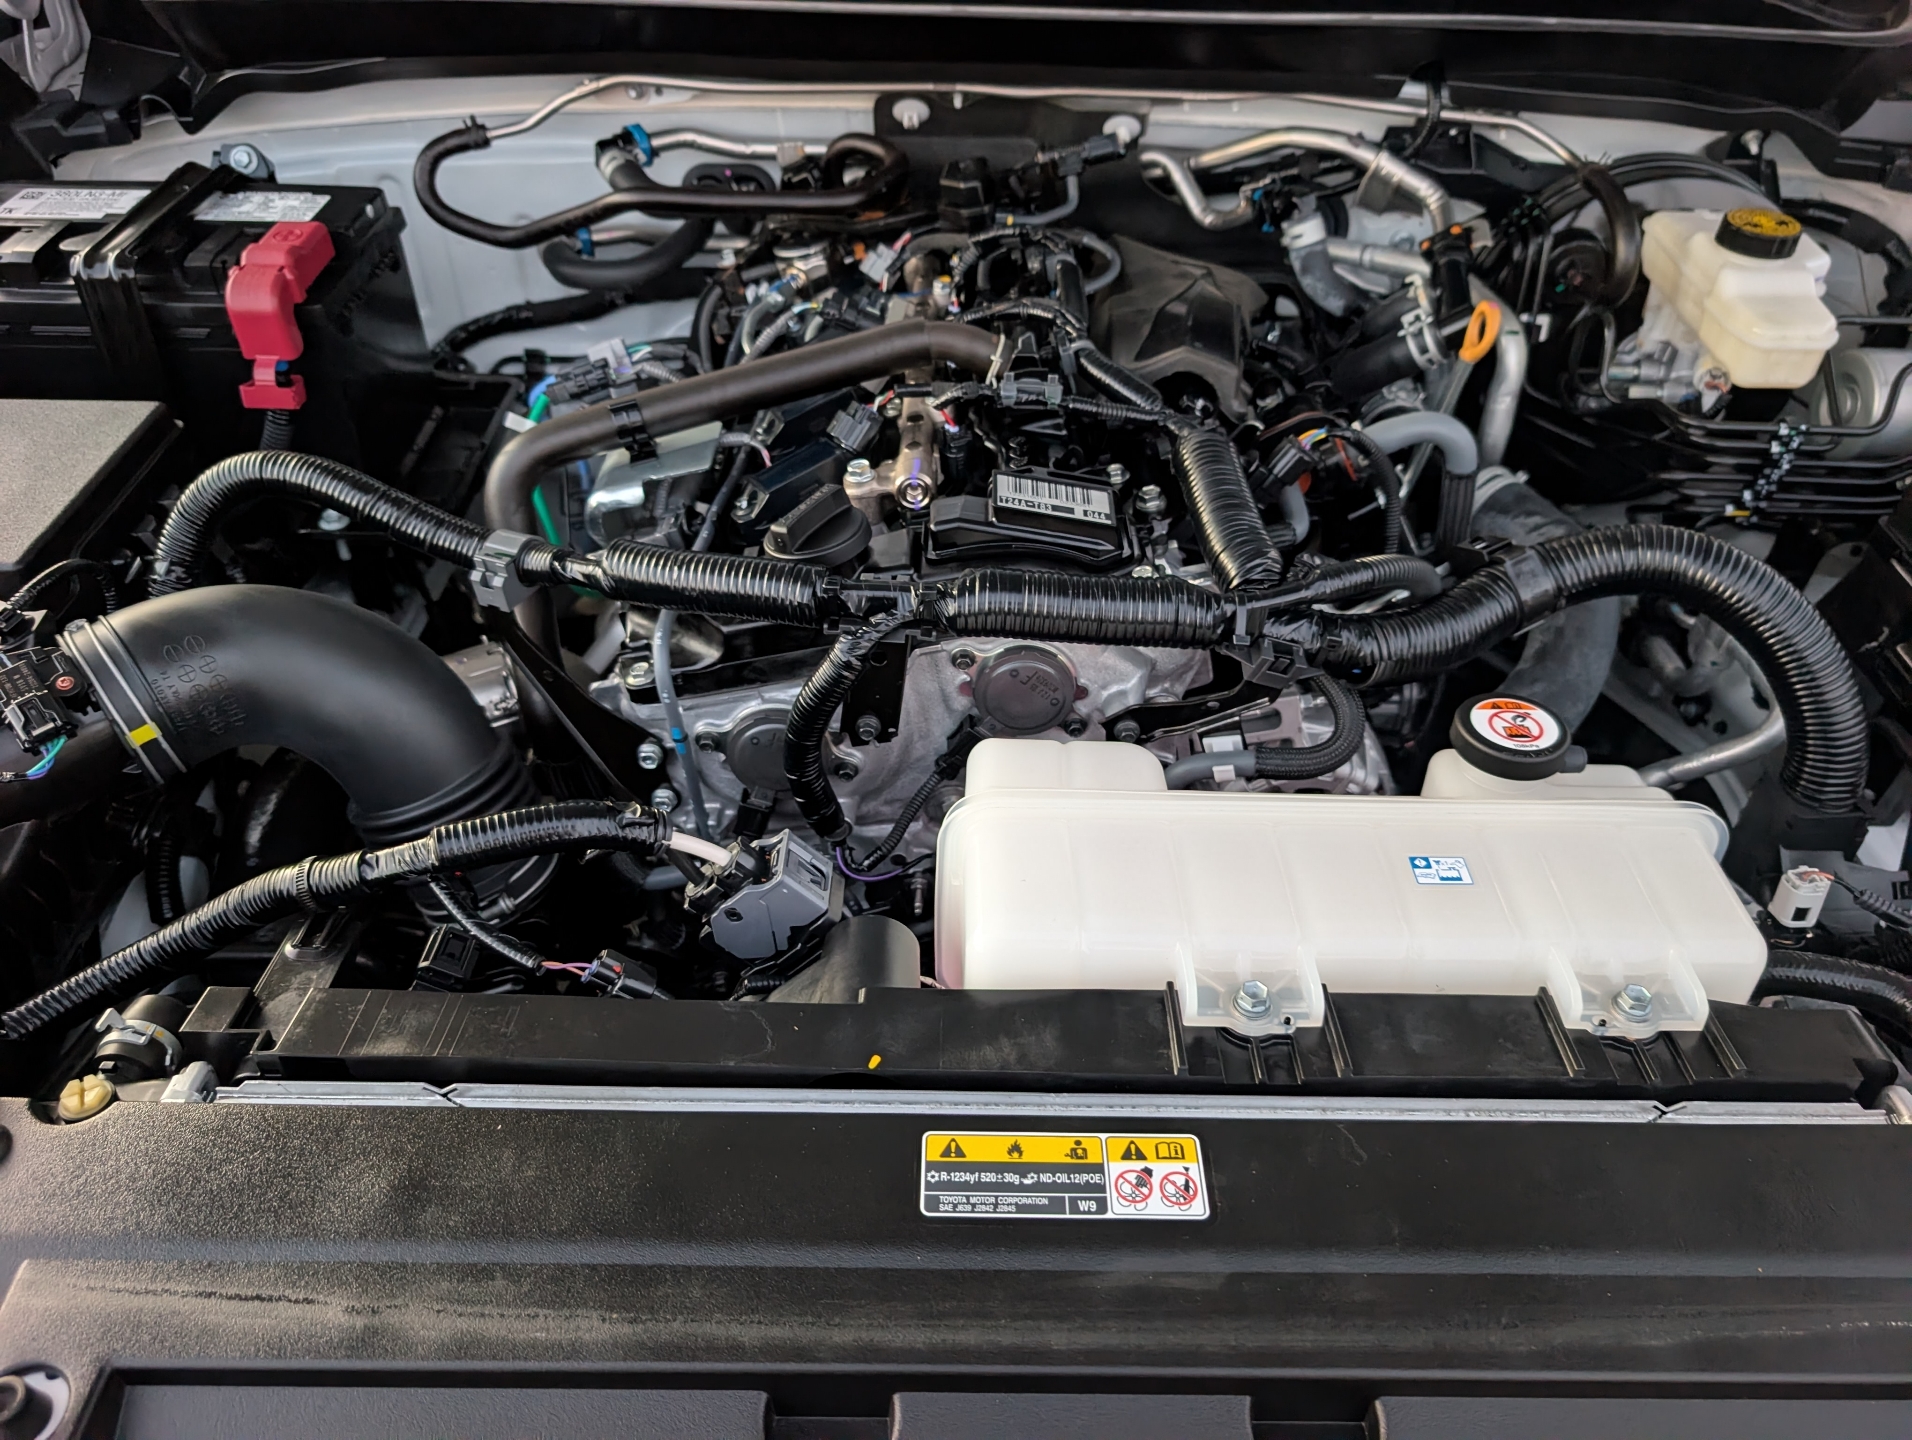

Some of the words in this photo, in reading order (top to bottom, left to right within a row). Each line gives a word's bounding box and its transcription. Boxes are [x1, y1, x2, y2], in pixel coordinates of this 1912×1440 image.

[1087, 510, 1106, 520] 044
[940, 1171, 979, 1184] R-1234yf
[980, 1172, 1020, 1185] 520±30g
[1039, 1172, 1104, 1185] ND-OIL12(POE)
[939, 1196, 967, 1204] TOYOTA
[969, 1196, 996, 1204] MOTOR
[997, 1196, 1049, 1205] CORPORATION
[938, 1203, 954, 1211] SAE
[955, 1204, 972, 1212] J639
[1077, 1200, 1097, 1212] W9
